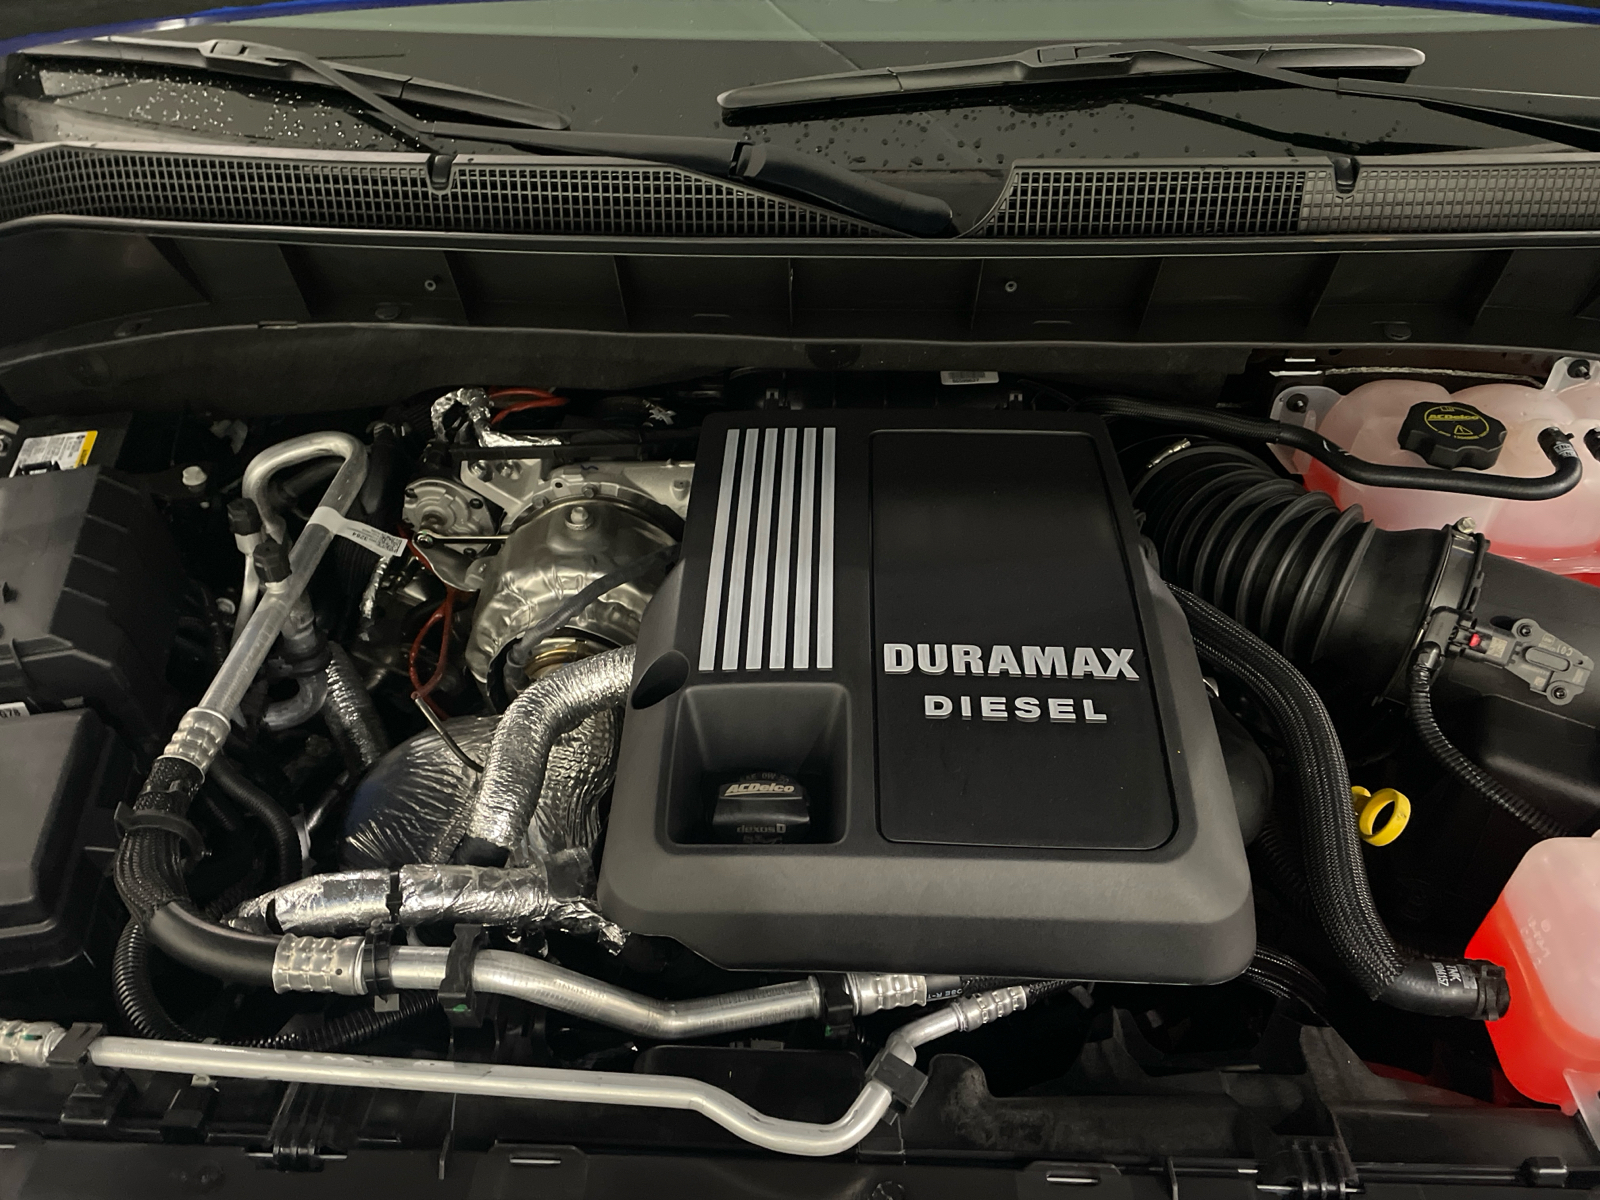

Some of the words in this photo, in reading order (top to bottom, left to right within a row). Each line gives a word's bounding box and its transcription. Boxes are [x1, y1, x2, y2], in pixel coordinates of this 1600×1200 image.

[883, 643, 1140, 681] DURAMAX
[924, 695, 1108, 723] DIESEL
[725, 783, 795, 796] ACDelco
